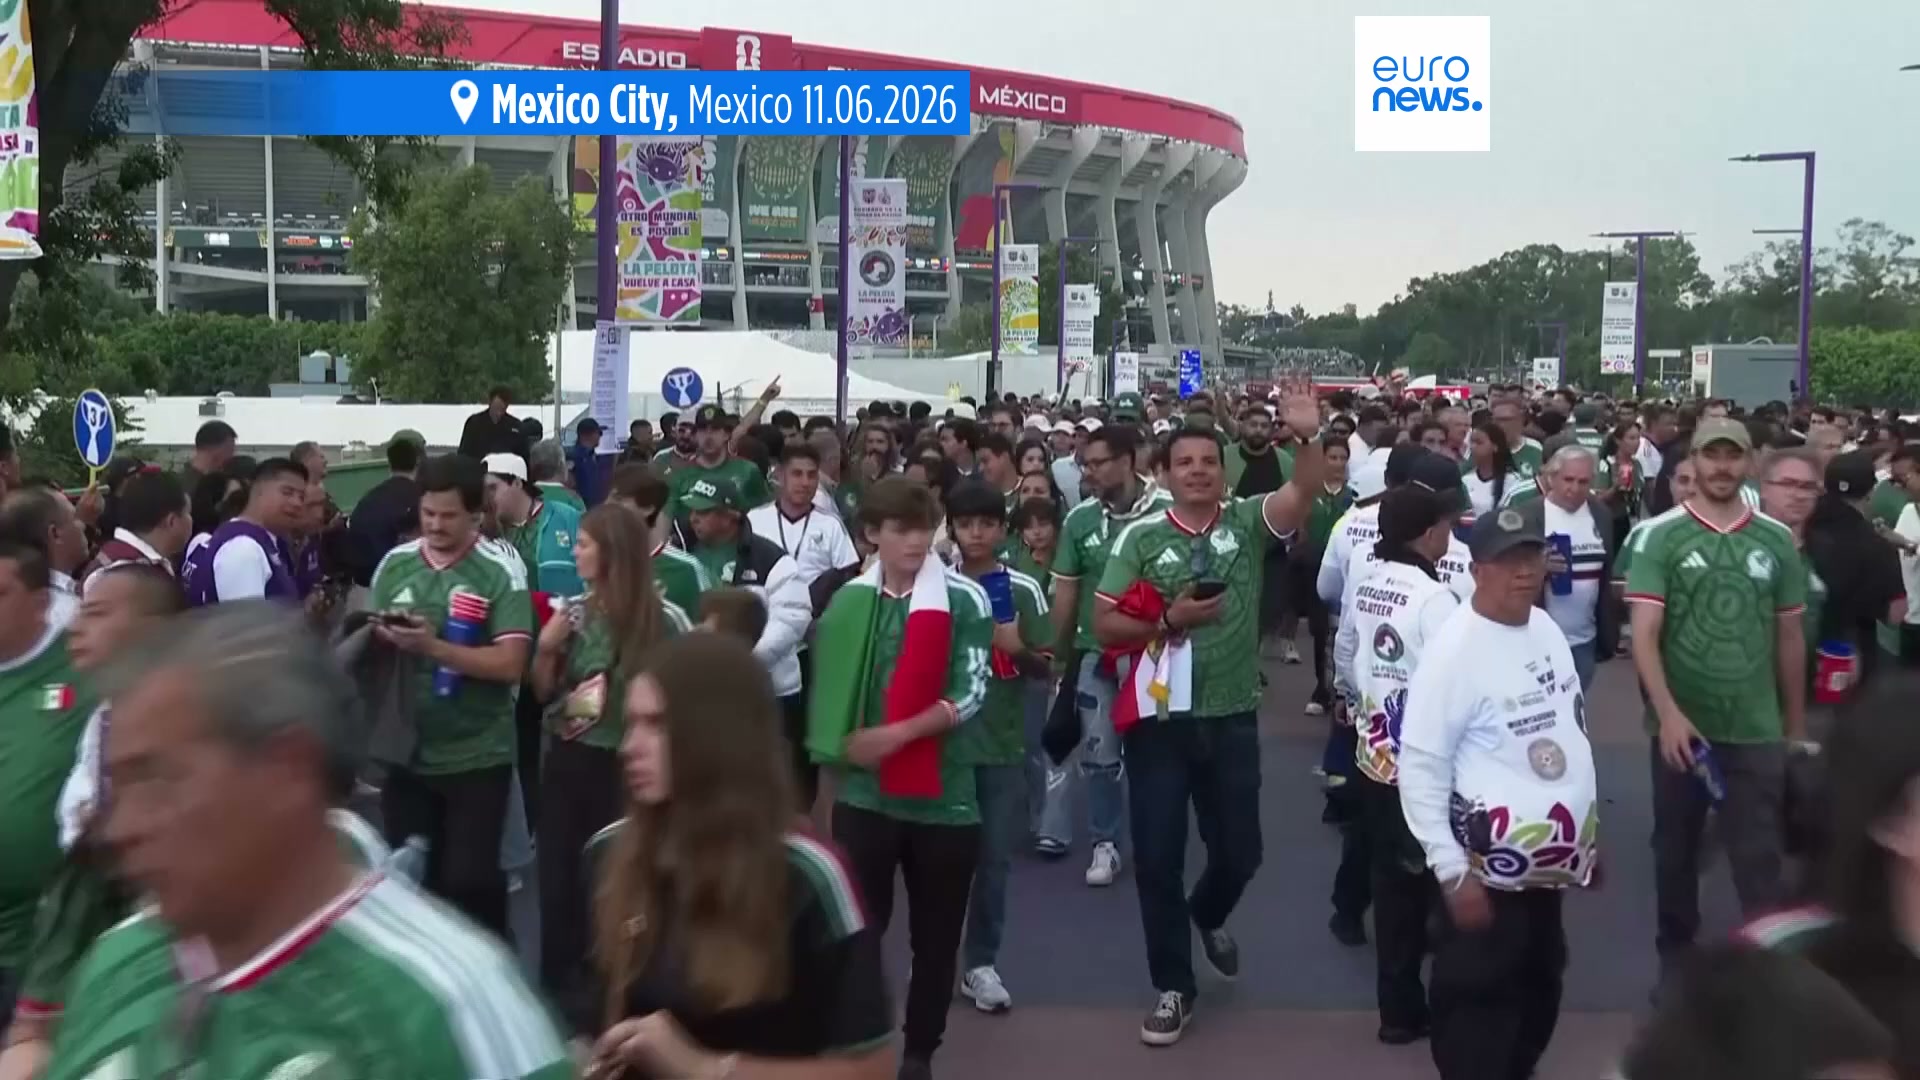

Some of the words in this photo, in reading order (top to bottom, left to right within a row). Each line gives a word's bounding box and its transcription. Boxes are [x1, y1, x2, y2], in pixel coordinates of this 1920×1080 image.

[563, 41, 686, 68] ESADIO
[979, 84, 1066, 113] MÉXICO
[621, 213, 648, 221] OTRO
[654, 212, 698, 221] MUNDIAL
[631, 227, 642, 236] ES
[624, 264, 640, 275] LA
[645, 263, 696, 275] PELOTA
[624, 278, 660, 287] VUELVE
[663, 279, 669, 287] A
[672, 279, 696, 287] CASA
[91, 407, 97, 427] 3
